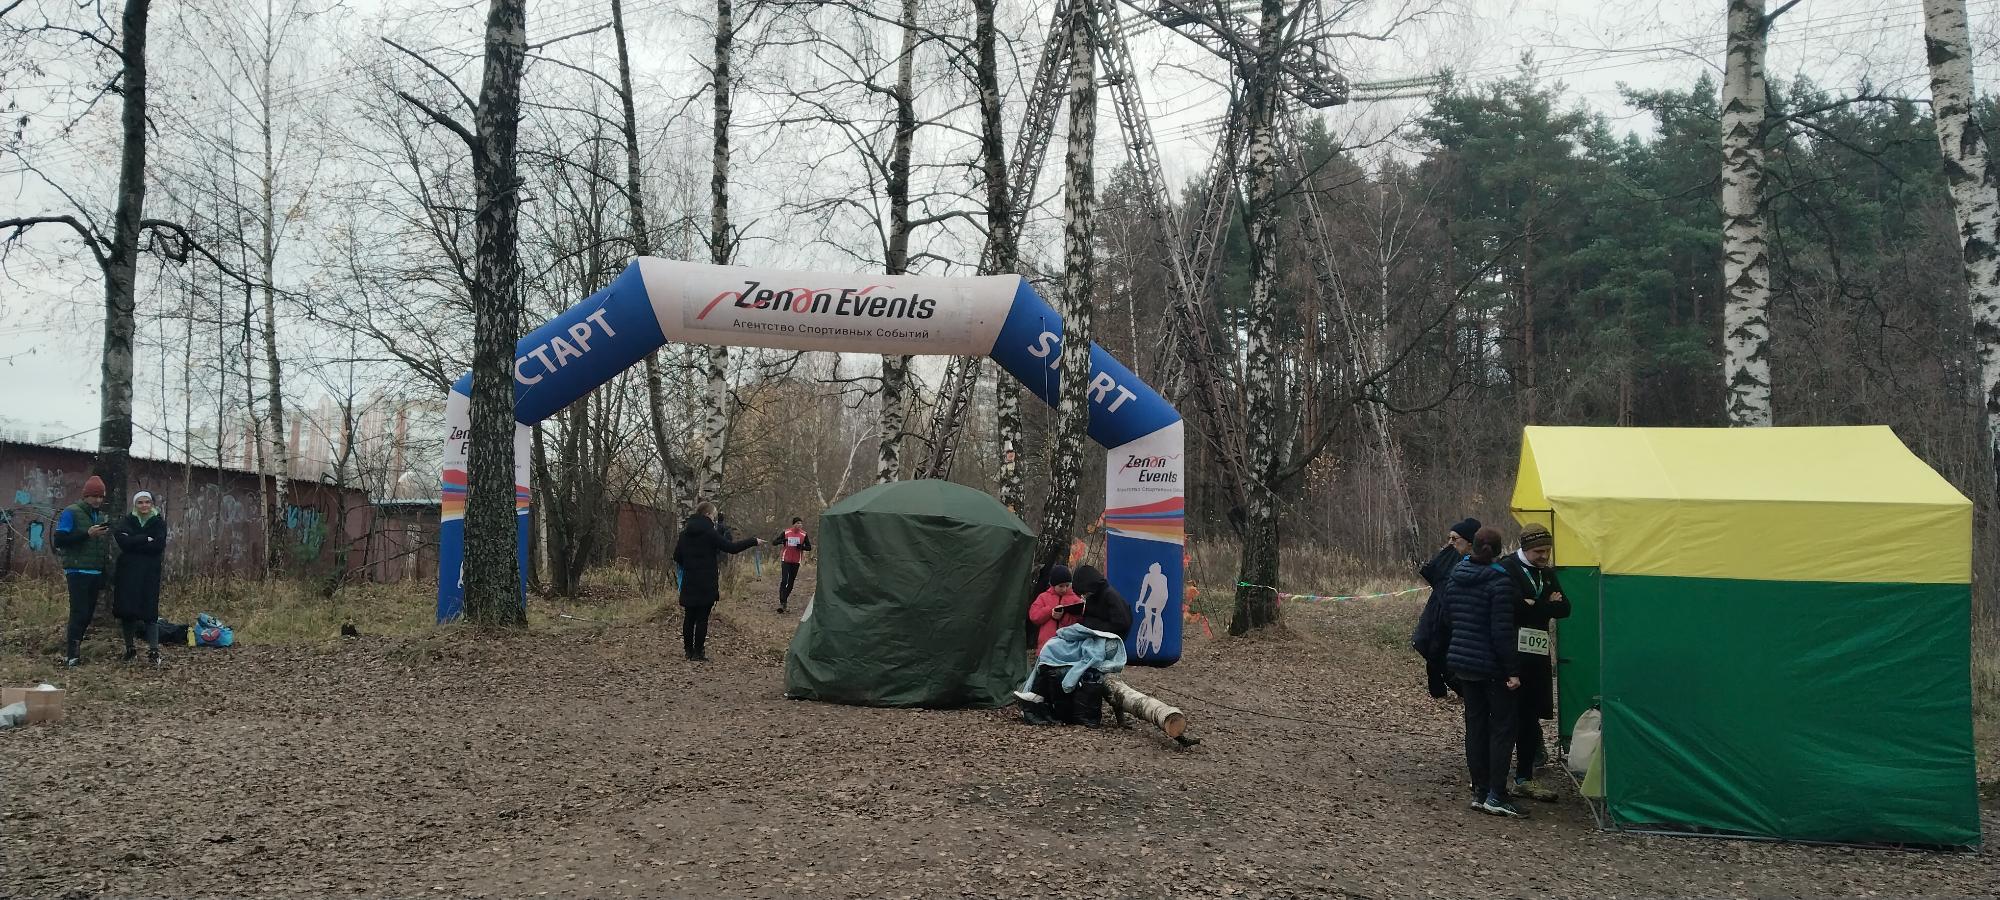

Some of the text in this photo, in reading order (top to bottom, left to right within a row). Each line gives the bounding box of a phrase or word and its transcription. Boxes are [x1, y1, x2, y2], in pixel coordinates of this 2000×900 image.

[734, 280, 937, 319] Zenon Events
[733, 318, 929, 339] Агентство Спортивных Событий
[515, 307, 616, 385] СТАРТ
[1027, 331, 1137, 414] SRT
[450, 426, 470, 440] Zen
[1126, 454, 1167, 468] Zenon
[1138, 469, 1178, 482] Events
[1528, 636, 1548, 649] 092
